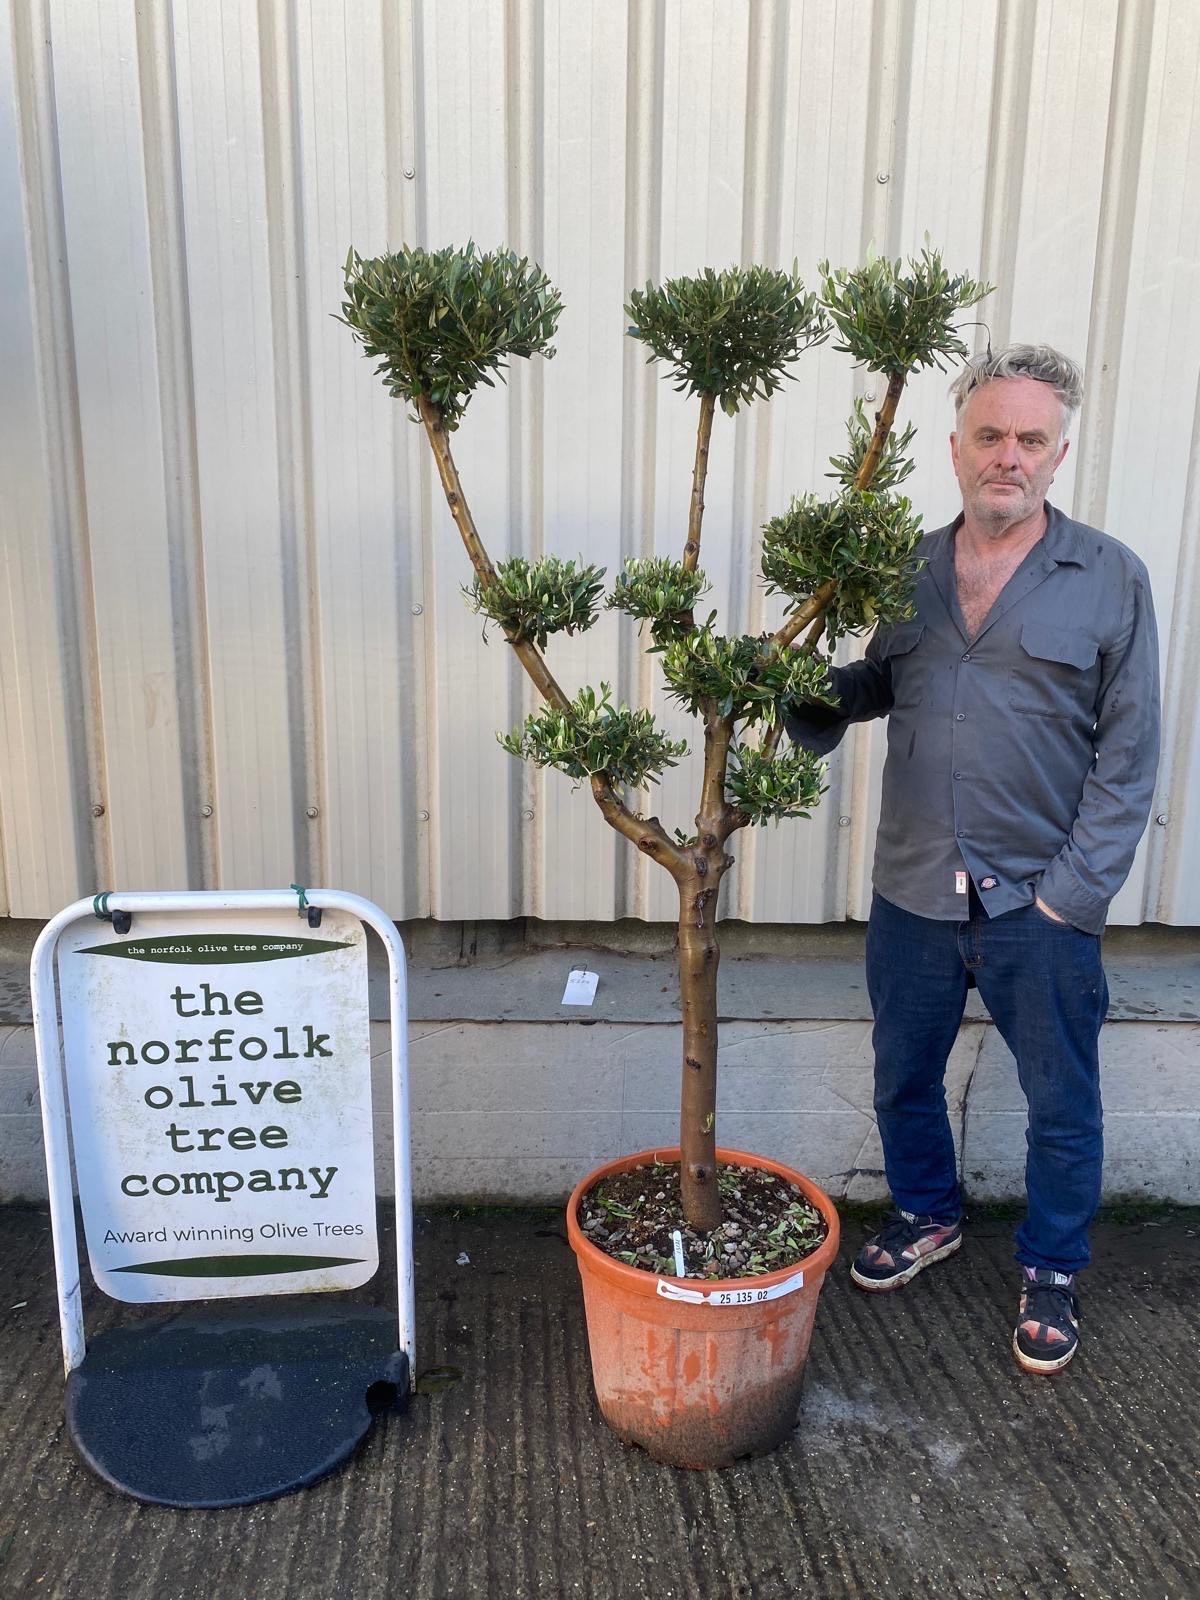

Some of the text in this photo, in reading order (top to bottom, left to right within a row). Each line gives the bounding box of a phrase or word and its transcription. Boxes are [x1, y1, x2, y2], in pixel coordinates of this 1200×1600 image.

[127, 943, 304, 955] the norfolk olive tree company
[170, 984, 263, 1017] the
[107, 1026, 333, 1065] norfolk
[145, 1075, 302, 1109] olive
[165, 1123, 288, 1153] tree
[121, 1167, 338, 1202] company
[104, 1223, 364, 1243] Award winning Olive Trees
[720, 1290, 769, 1305] 25 135 02
